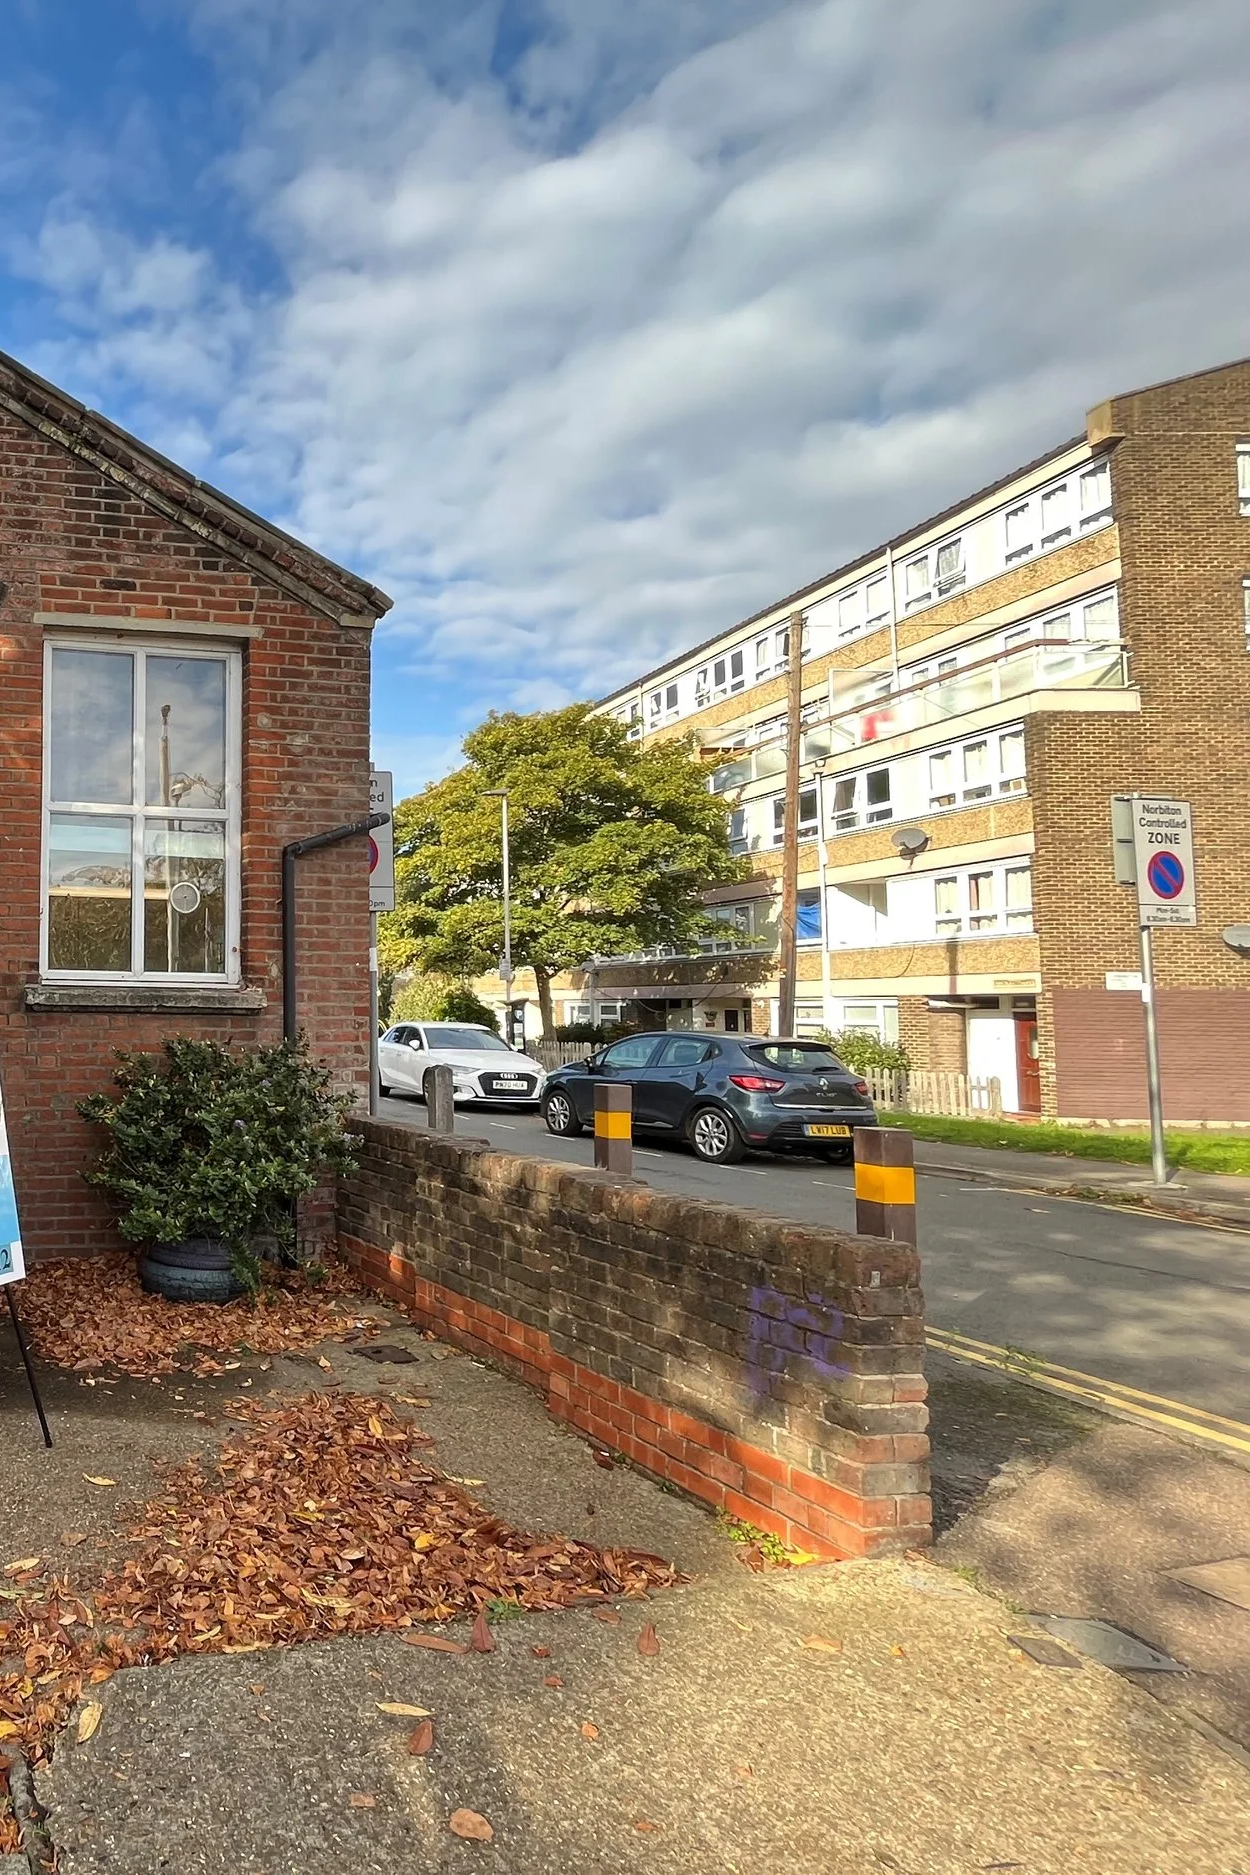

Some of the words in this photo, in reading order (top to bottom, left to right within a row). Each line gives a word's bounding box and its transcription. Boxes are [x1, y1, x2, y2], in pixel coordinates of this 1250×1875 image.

[1142, 804, 1182, 816] Norbiton
[1138, 817, 1187, 829] Controlled
[1147, 832, 1181, 845] ZONE
